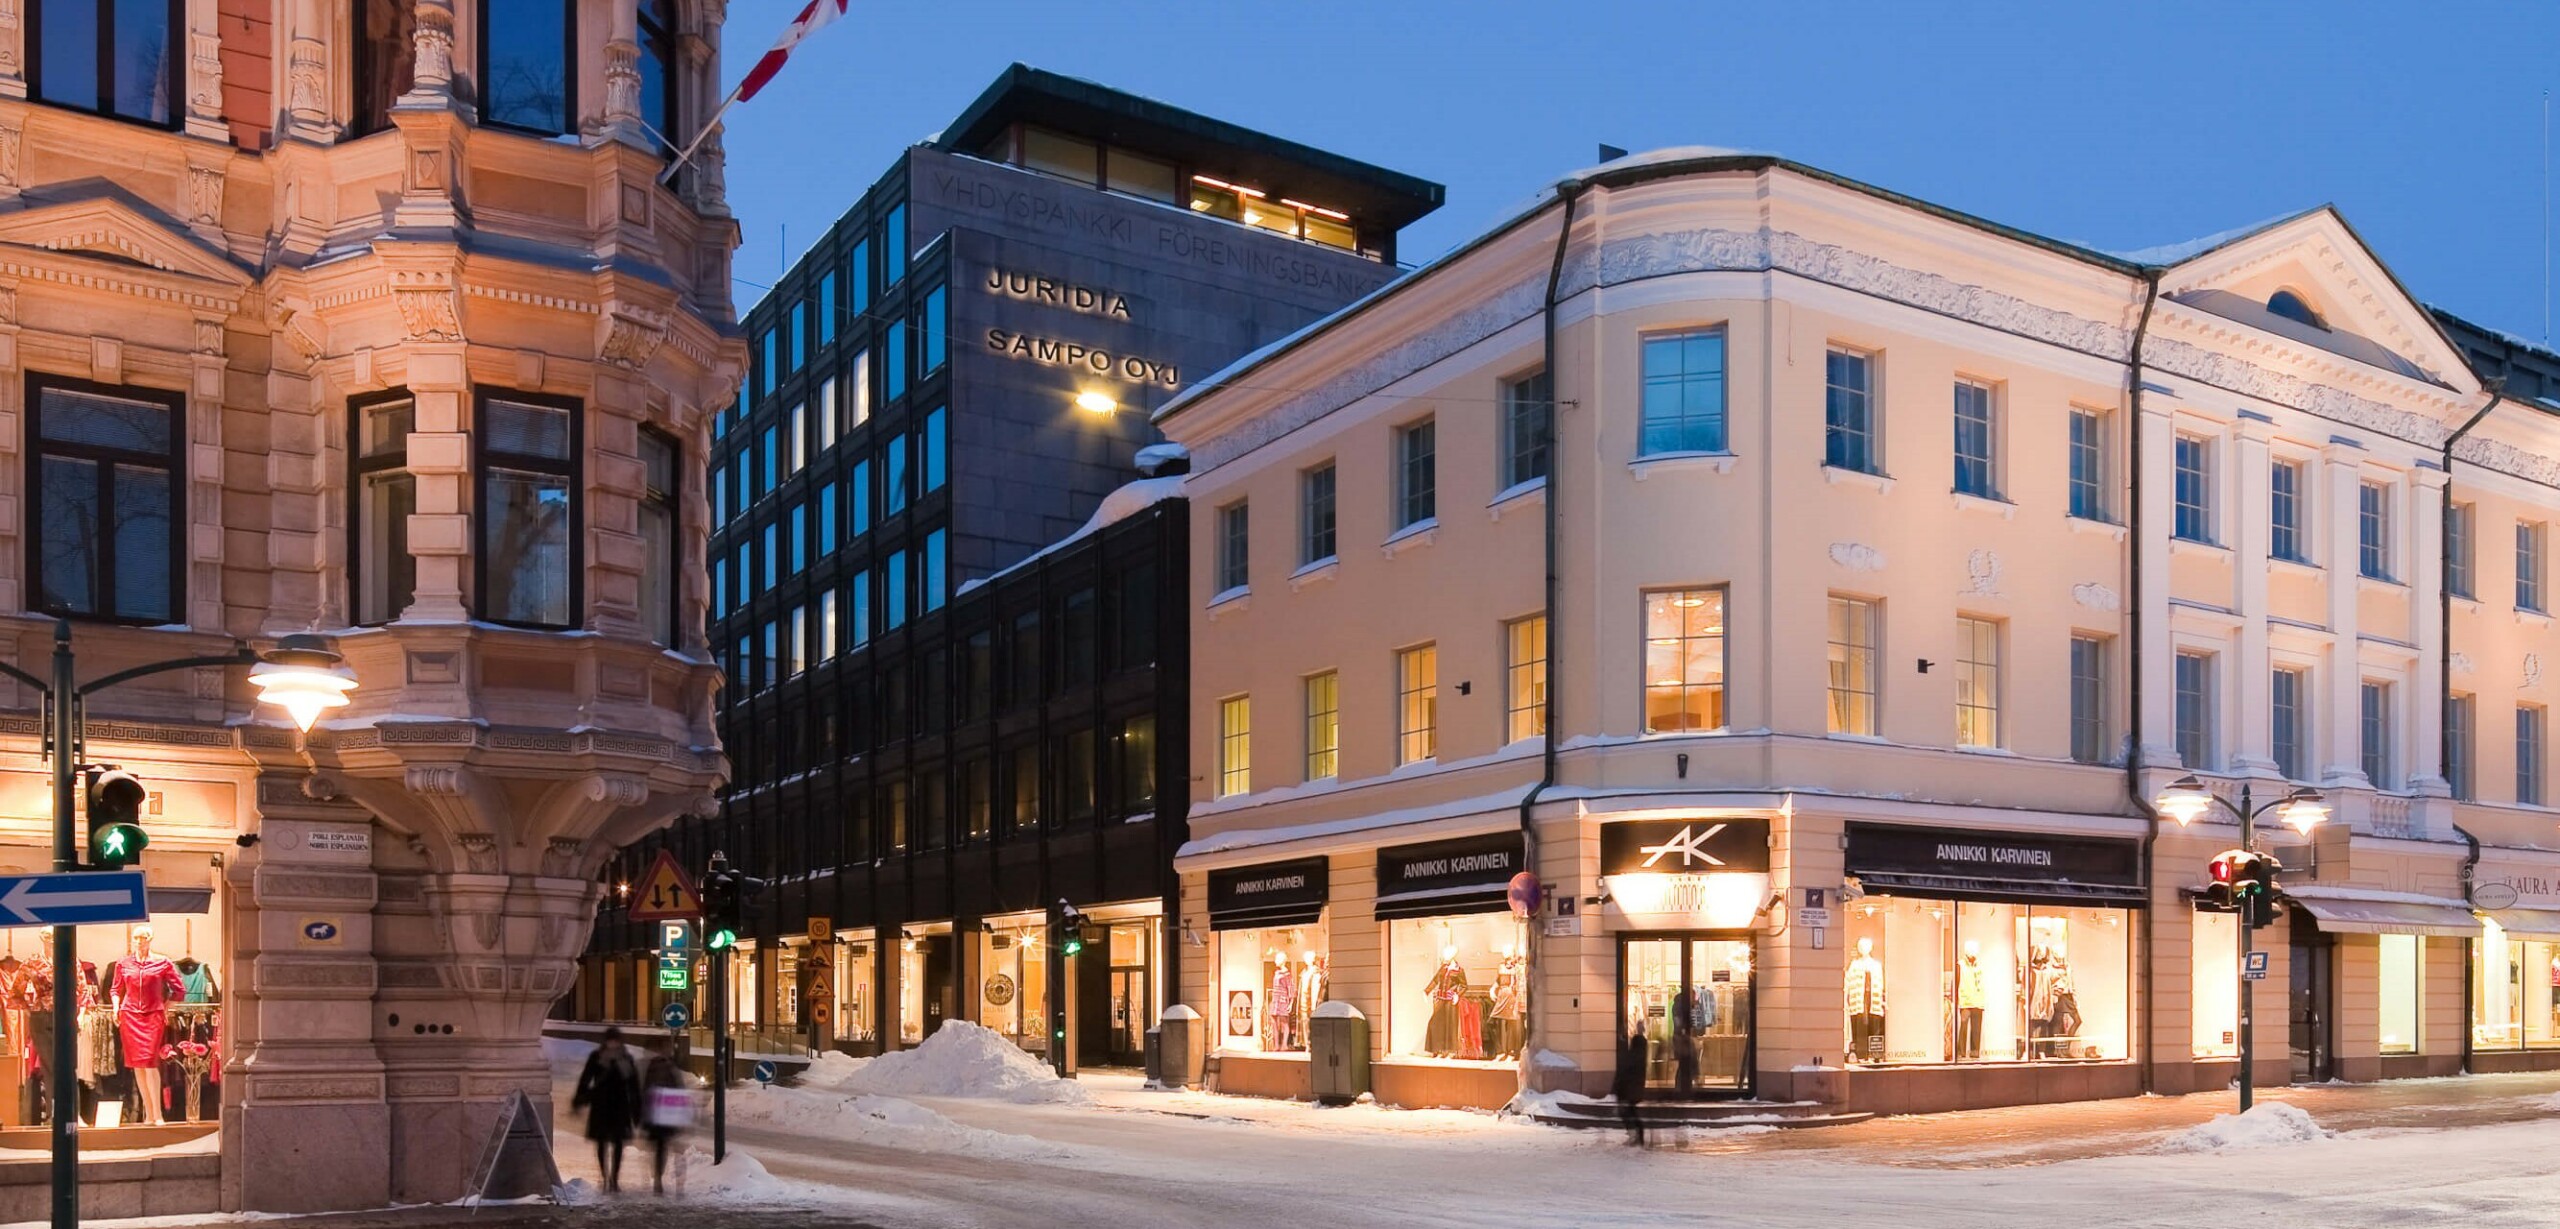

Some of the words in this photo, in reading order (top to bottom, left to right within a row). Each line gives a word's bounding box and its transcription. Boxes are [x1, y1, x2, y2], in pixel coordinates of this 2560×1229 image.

[935, 172, 1132, 243] YHDYSPANKKI
[989, 267, 1131, 318] JURIDIA
[989, 329, 1111, 376] SAMPO
[1125, 357, 1178, 385] OYJ
[1640, 824, 1728, 867] AK
[1936, 844, 1987, 861] ANNIKKI
[1991, 847, 2051, 865] KARVINEN
[1403, 860, 1447, 878] ANNIKKI
[1451, 852, 1509, 873] KARVINEN
[1236, 881, 1265, 895] ANNIKKI
[1265, 875, 1305, 891] KARVINEN
[666, 926, 683, 947] P
